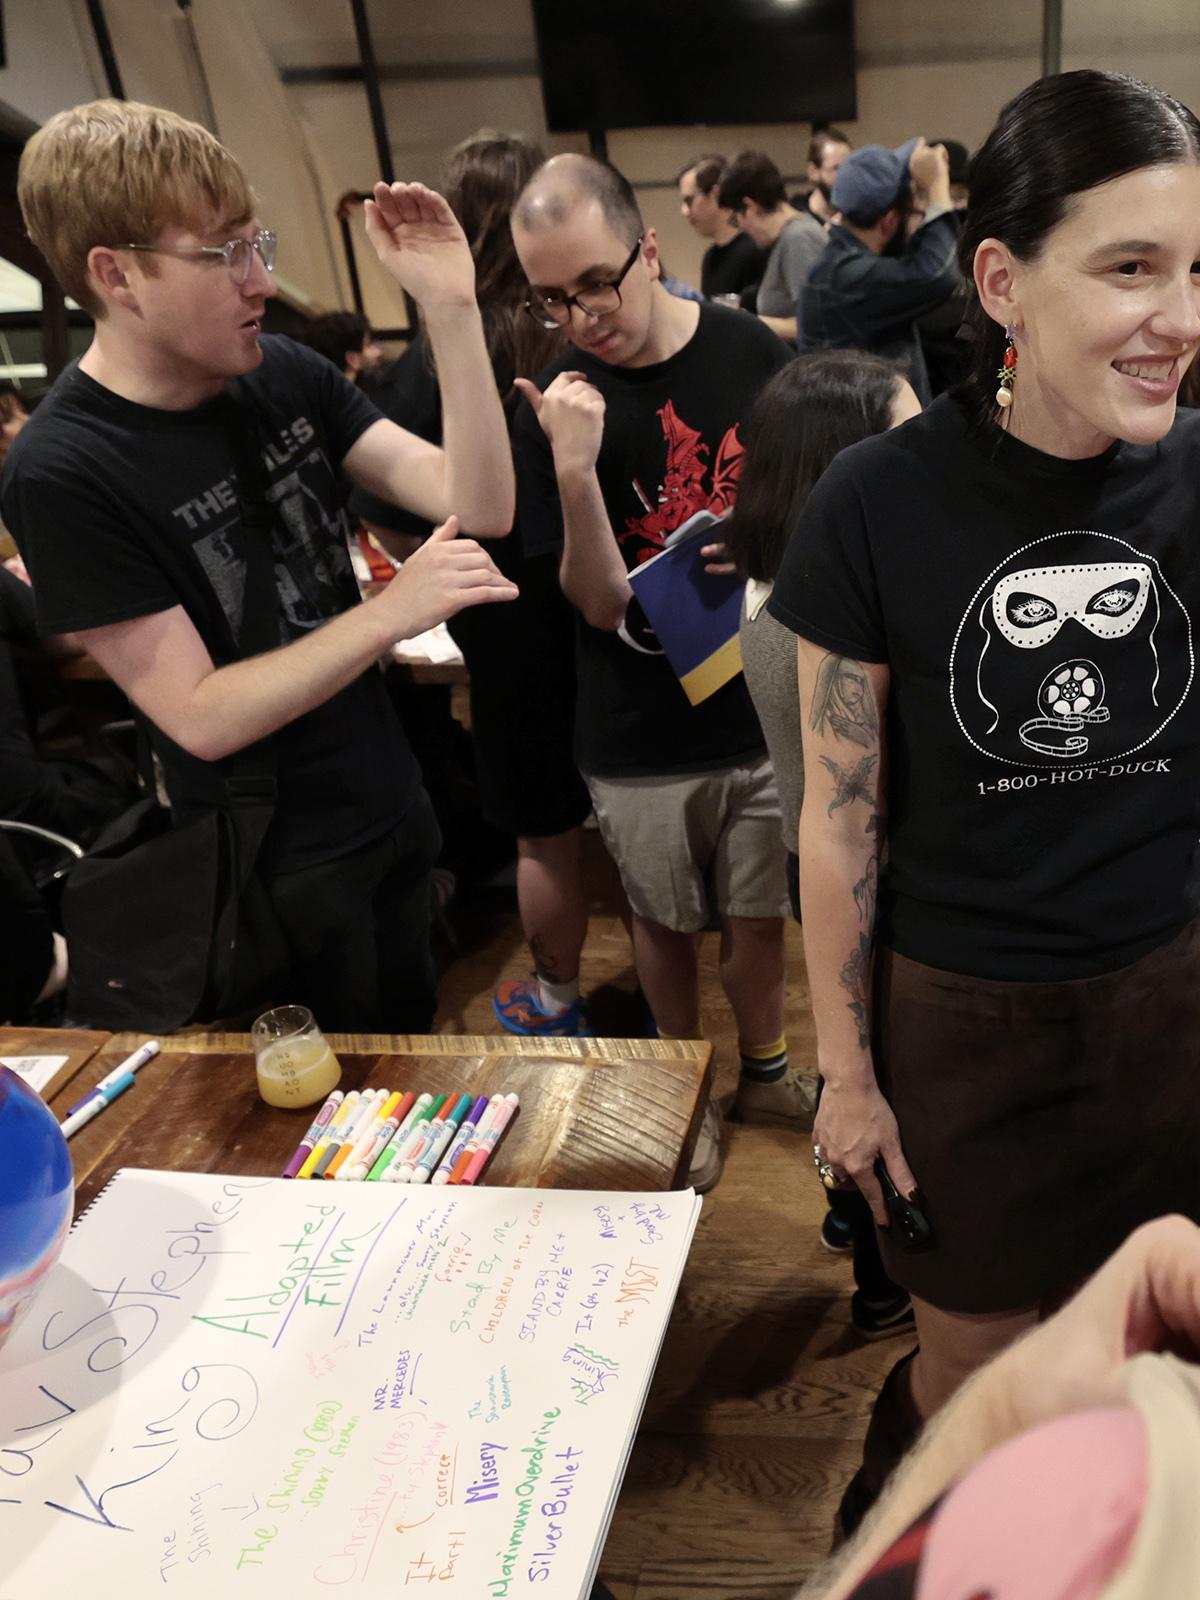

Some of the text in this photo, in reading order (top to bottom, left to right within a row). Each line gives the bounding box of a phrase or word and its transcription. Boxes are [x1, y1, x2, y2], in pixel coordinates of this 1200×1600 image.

[172, 480, 237, 529] THE
[977, 758, 1172, 795] 1-800-HOT-DUCK
[437, 1236, 449, 1247] 2
[592, 1205, 618, 1239] Misery
[43, 1180, 275, 1373] Stephen
[191, 1204, 337, 1340] Adapted
[304, 1221, 382, 1306] Film
[450, 1215, 519, 1334] Stand By Me
[614, 1256, 660, 1328] The MIST
[358, 1322, 378, 1348] The
[518, 1291, 547, 1344] STAND
[574, 1313, 593, 1335] It
[389, 1349, 412, 1410] MERCEDES
[44, 1363, 259, 1532] King
[464, 1442, 509, 1505] Misery
[187, 1482, 223, 1563] Shining
[236, 1524, 279, 1572] The
[265, 1448, 317, 1515] Shining
[312, 1411, 429, 1586] Christine (1983)
[487, 1406, 562, 1597] Maximum Overdrive
[528, 1446, 584, 1583] Silver Bullet
[160, 1529, 180, 1584] The
[404, 1551, 437, 1586] It
